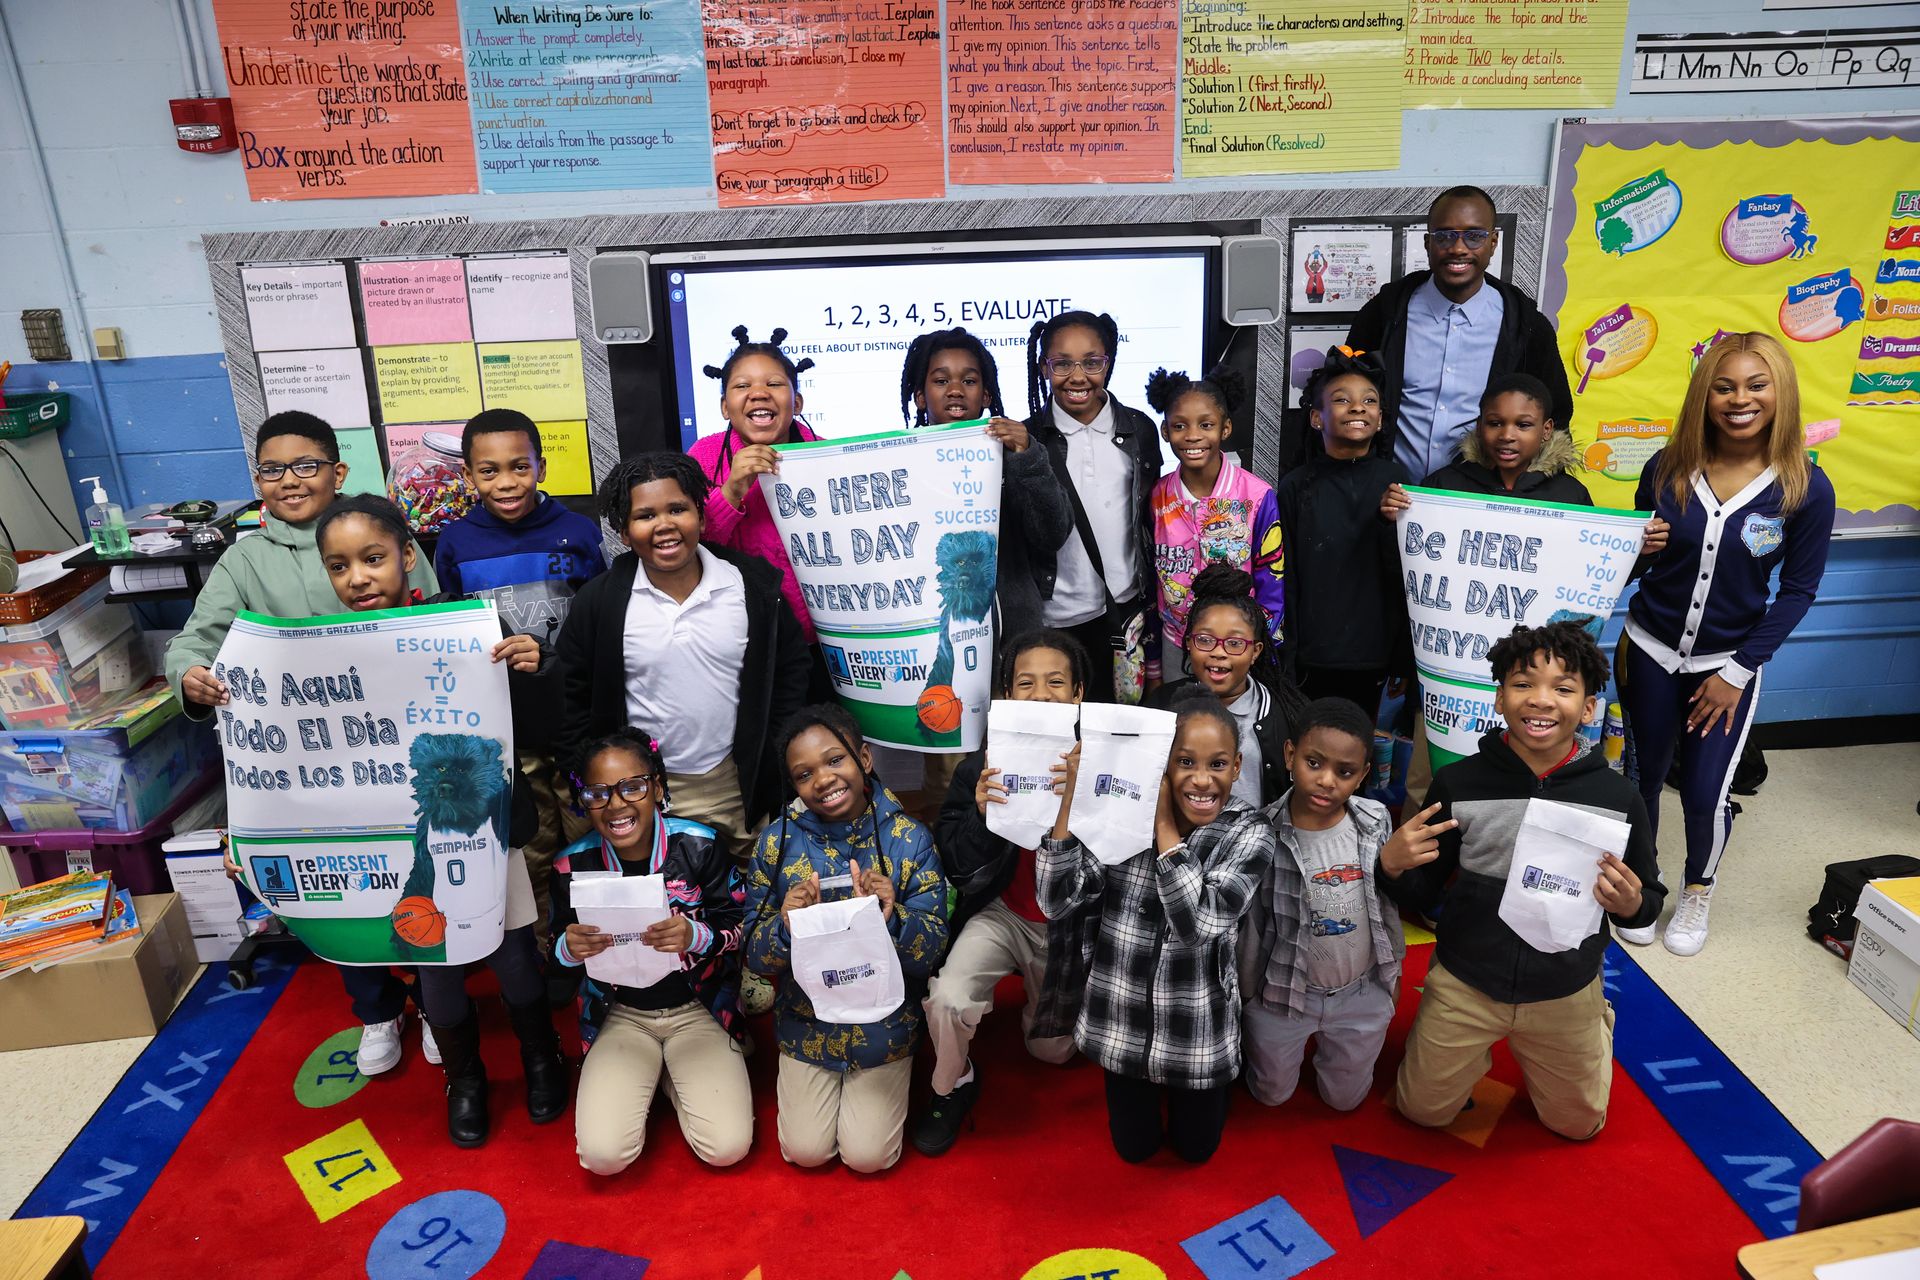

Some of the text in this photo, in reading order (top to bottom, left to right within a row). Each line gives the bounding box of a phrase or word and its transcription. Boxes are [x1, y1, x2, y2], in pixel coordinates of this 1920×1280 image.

[494, 7, 529, 27] When
[534, 7, 581, 27] Writing
[585, 7, 601, 22] Be
[606, 5, 633, 21] Sure
[293, 19, 306, 40] of
[310, 21, 341, 47] your
[520, 30, 535, 44] the
[544, 31, 579, 48] prompt
[1420, 33, 1446, 44] main
[1421, 48, 1564, 69] Provide TWO key details.
[1679, 53, 1721, 79] Mm
[1730, 52, 1761, 77] Nn
[1775, 50, 1808, 76] Oo
[1832, 49, 1861, 84] Pp
[1876, 47, 1911, 82] Qq
[318, 78, 467, 105] questions that state
[323, 106, 389, 132] your job.
[295, 138, 444, 166] around the action
[1022, 137, 1063, 152] restate
[1070, 141, 1084, 156] my
[1222, 136, 1264, 152] Solution
[297, 166, 346, 187] verbs.
[718, 173, 742, 189] Give
[746, 175, 769, 190] your
[776, 170, 833, 193] paragraph
[837, 174, 844, 184] a
[1601, 176, 1660, 212] Informational
[1748, 203, 1781, 212] Fantasy
[246, 281, 343, 292] Key Details important
[470, 275, 502, 283] Identify
[512, 273, 551, 282] recognize
[1796, 278, 1840, 295] Biography
[248, 293, 273, 302] words
[287, 292, 318, 301] phrases
[369, 298, 399, 307] created
[401, 298, 411, 307] by
[426, 296, 464, 305] illustrator
[1592, 313, 1624, 336] Tall Tale
[802, 344, 860, 353] FEEL ABOUT
[263, 365, 306, 374] Determine
[265, 376, 301, 385] conclude
[315, 373, 350, 382] ascertain
[267, 386, 328, 396] after reasoning
[1877, 375, 1914, 390] Poetry
[1602, 425, 1636, 433] Realistic
[843, 436, 918, 453] MEMPHIS GRIZZLIES
[937, 449, 995, 462] SCHOOL
[775, 469, 911, 519] Be HERE
[953, 482, 982, 495] YOU
[935, 509, 997, 524] SUCCESS
[1486, 503, 1564, 518] MEMPHIS GRIZZLIES
[791, 522, 920, 567] ALL DAY
[1405, 522, 1543, 573] Be HERE
[1579, 530, 1636, 554] SCHOOL
[548, 553, 574, 575] 23
[1586, 565, 1617, 581] YOU
[801, 576, 926, 612] EVERYDAY
[1406, 570, 1538, 621] ALL DAY
[279, 623, 378, 638] MEMPHIS GRIZZLIES
[397, 638, 482, 653] ESCUELA
[848, 648, 918, 665] rePRESENT
[425, 671, 456, 693] TÚ
[406, 701, 481, 727] ÉXITO
[222, 710, 287, 753] Todo
[298, 718, 332, 752] El
[227, 759, 292, 791] Todos
[299, 764, 345, 790] Los
[430, 837, 487, 856] MEMPHIS
[296, 855, 388, 874] rePRESENT
[1869, 903, 1906, 933] Office DEPOT
[1861, 932, 1885, 956] copy
[313, 1148, 378, 1192] 17
[401, 1215, 473, 1270] 16
[1218, 1218, 1296, 1272] 11
